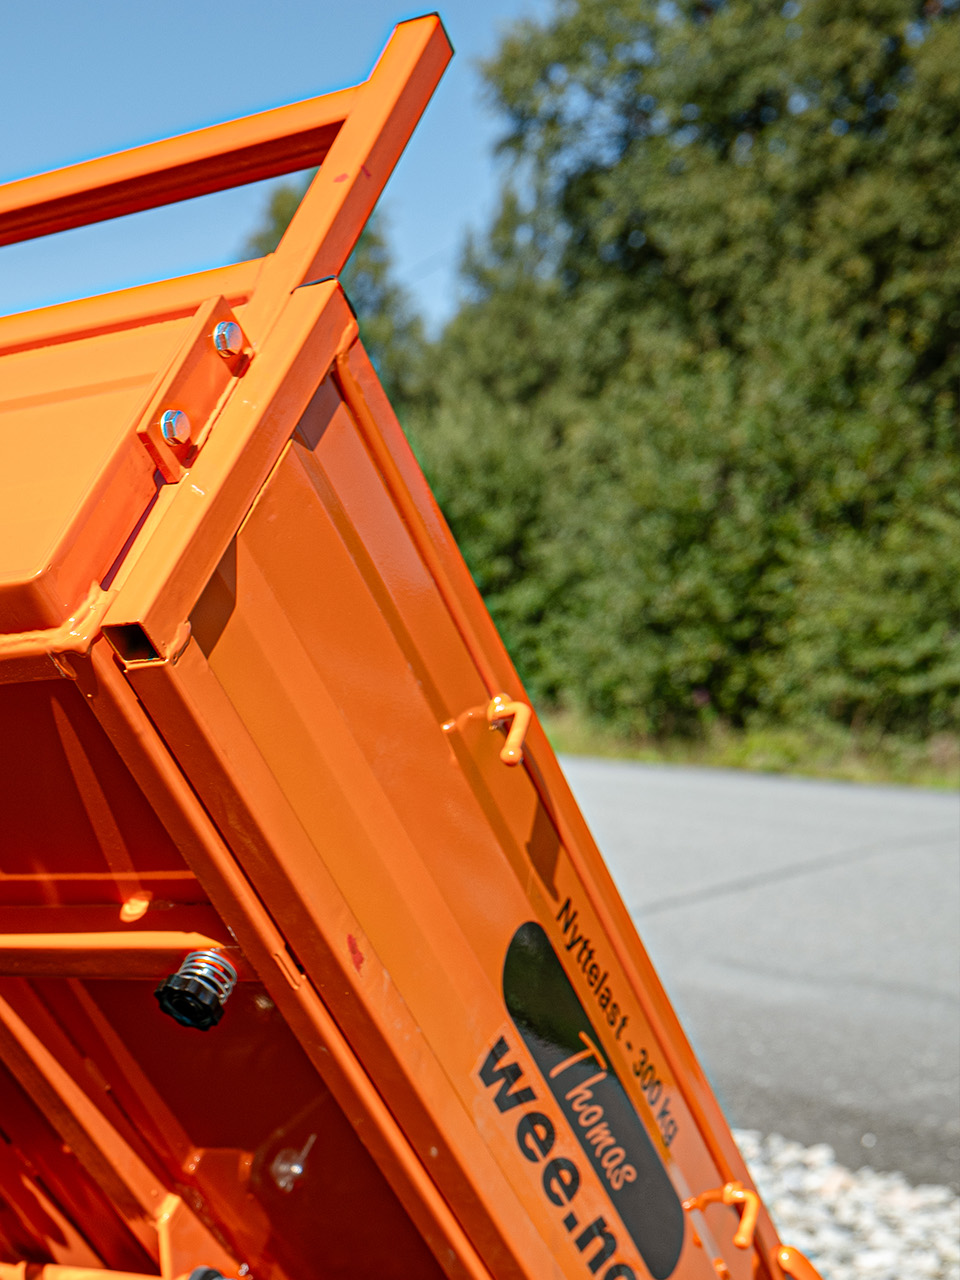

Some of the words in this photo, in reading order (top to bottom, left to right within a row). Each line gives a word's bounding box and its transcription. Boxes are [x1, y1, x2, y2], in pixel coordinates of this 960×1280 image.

[549, 1031, 638, 1191] Thomas
[556, 898, 628, 1040] Nyttelast
[633, 1048, 663, 1106] 300
[656, 1097, 678, 1147] kg
